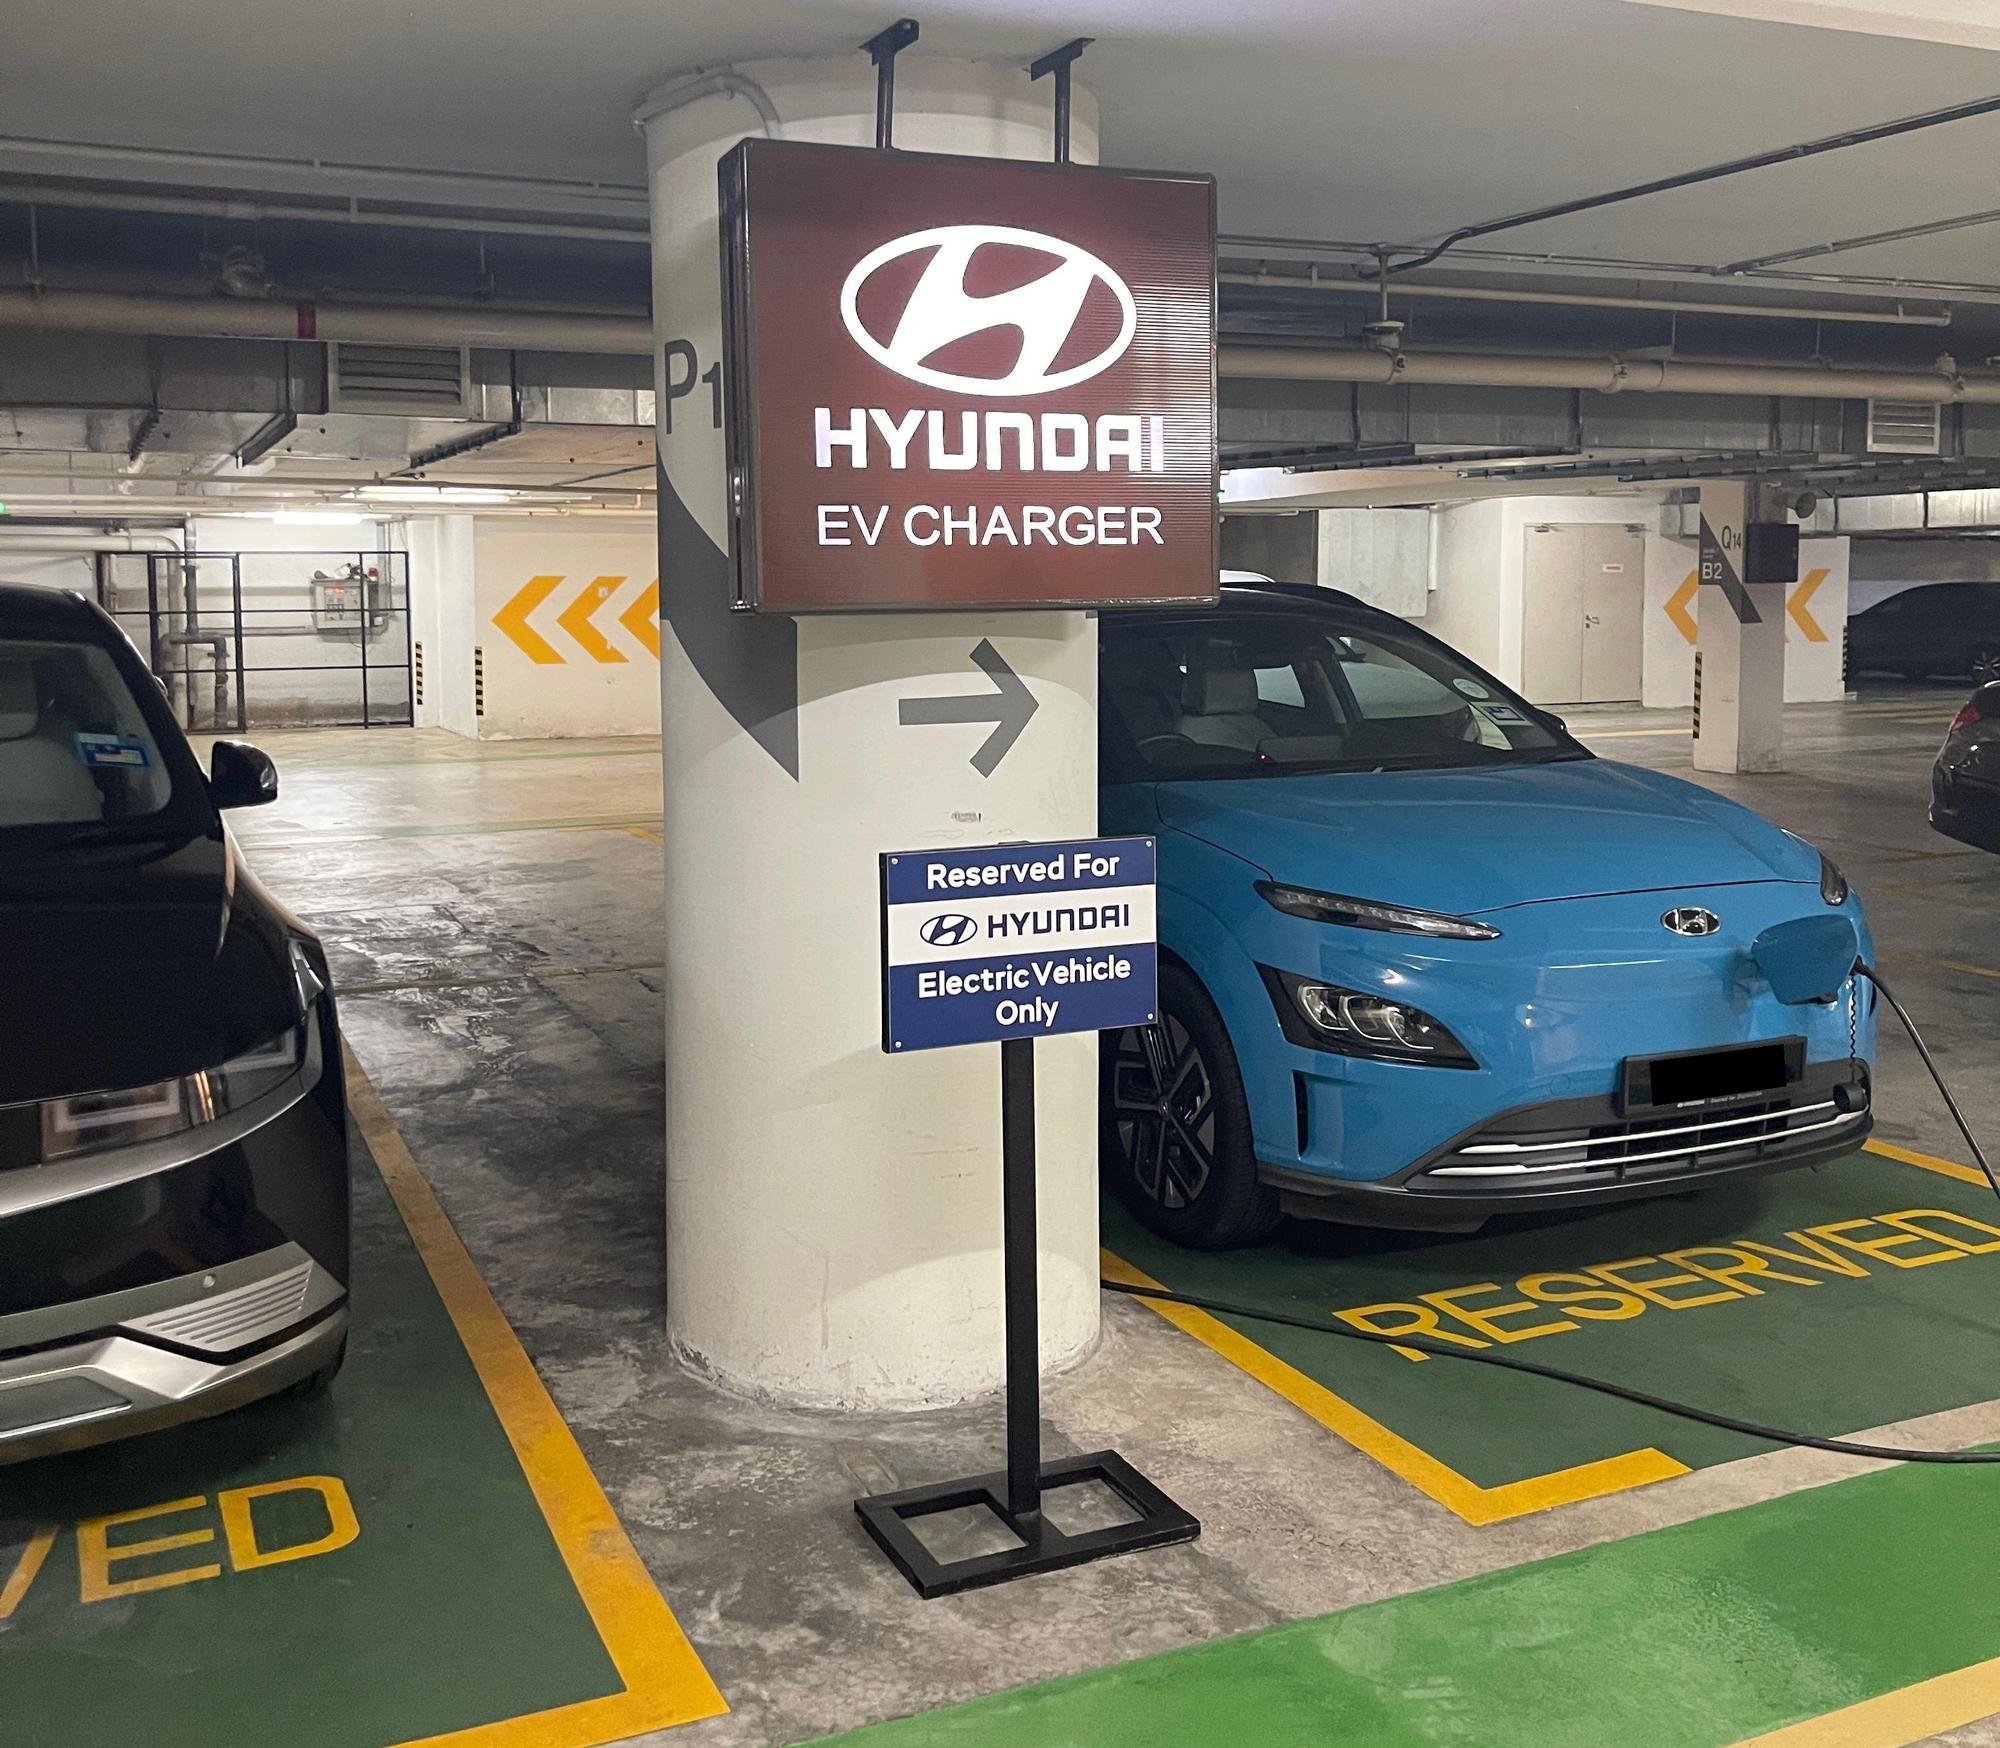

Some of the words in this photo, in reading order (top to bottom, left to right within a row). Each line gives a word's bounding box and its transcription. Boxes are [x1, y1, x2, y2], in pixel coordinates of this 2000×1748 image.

[664, 338, 722, 434] P1
[814, 407, 1164, 472] HYUNDAI
[817, 505, 888, 546] EV
[903, 505, 1164, 546] CHARGER
[1702, 562, 1722, 579] B2
[927, 854, 1065, 889] Reserved
[1073, 853, 1120, 879] For
[988, 904, 1129, 938] HYUNDAI
[918, 964, 1029, 998] Electric
[1031, 954, 1131, 986] Vehicle
[995, 996, 1059, 1027] Only
[1331, 1208, 2000, 1362] RESERVED
